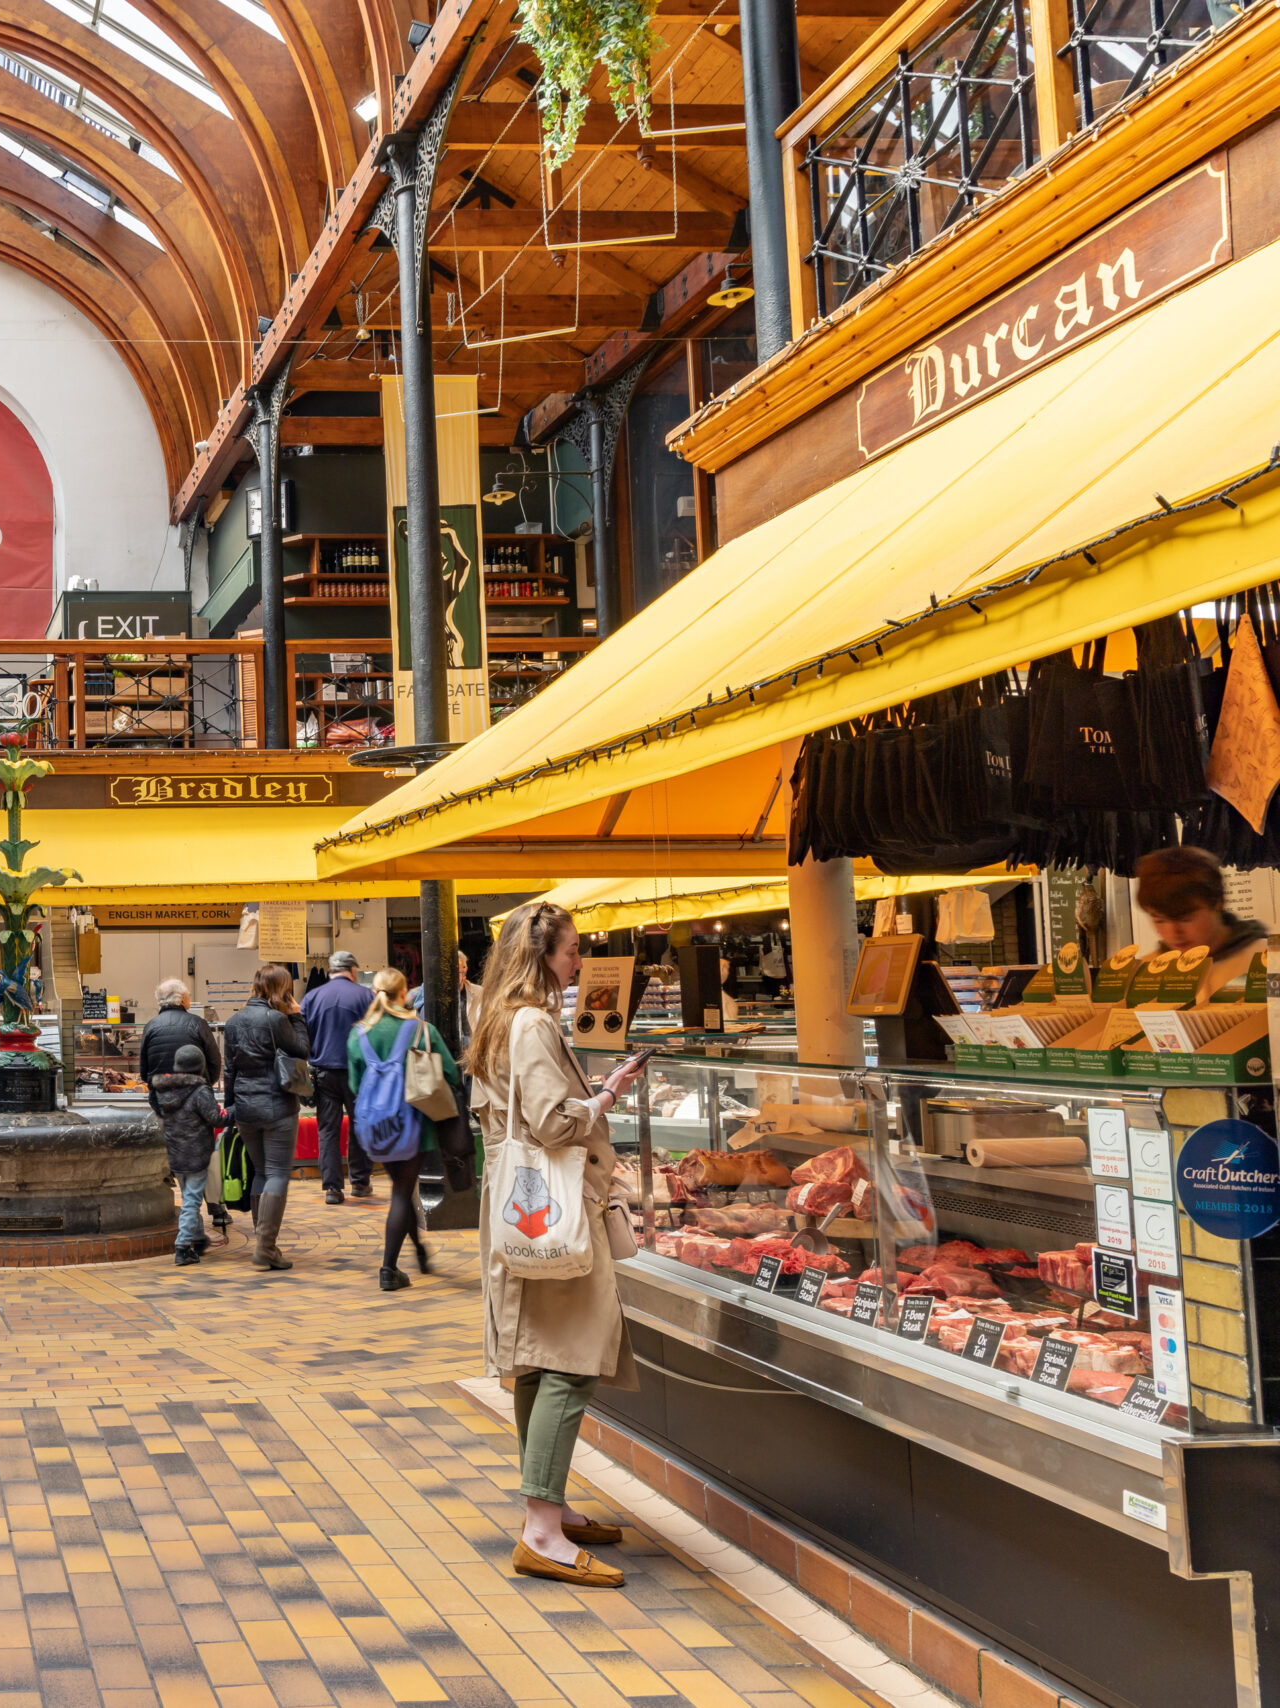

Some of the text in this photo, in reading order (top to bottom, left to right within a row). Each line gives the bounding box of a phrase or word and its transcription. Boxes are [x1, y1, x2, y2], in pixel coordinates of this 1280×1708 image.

[906, 246, 1144, 426] Durcan
[97, 616, 160, 638] EXIT
[397, 682, 486, 699] FAGATE
[131, 776, 309, 804] Bradley
[108, 910, 231, 920] ENGLISH MARKET, CORK
[1101, 1164, 1119, 1174] 2016
[1183, 1166, 1217, 1182] Craft
[1193, 1182, 1219, 1190] Associated
[1195, 1199, 1273, 1214] MEMBER 2018
[1107, 1235, 1122, 1245] 2019
[503, 1241, 570, 1260] bookstart
[1148, 1258, 1167, 1270] 2018
[759, 1267, 772, 1279] Fillet
[755, 1276, 770, 1289] Steak
[801, 1279, 819, 1293] Ribeye
[798, 1289, 815, 1303] Steak
[853, 1295, 878, 1311] Striploin
[1158, 1296, 1174, 1306] VISA
[854, 1307, 871, 1320] Steak
[904, 1309, 926, 1321] T-Bone
[902, 1321, 922, 1332] Steak
[977, 1333, 988, 1347] Ox
[973, 1345, 986, 1358] Tail
[1042, 1363, 1061, 1376] Rump
[1038, 1372, 1058, 1386] Steak
[1130, 1391, 1161, 1410] Corned
[1118, 1401, 1159, 1422] Silverside
